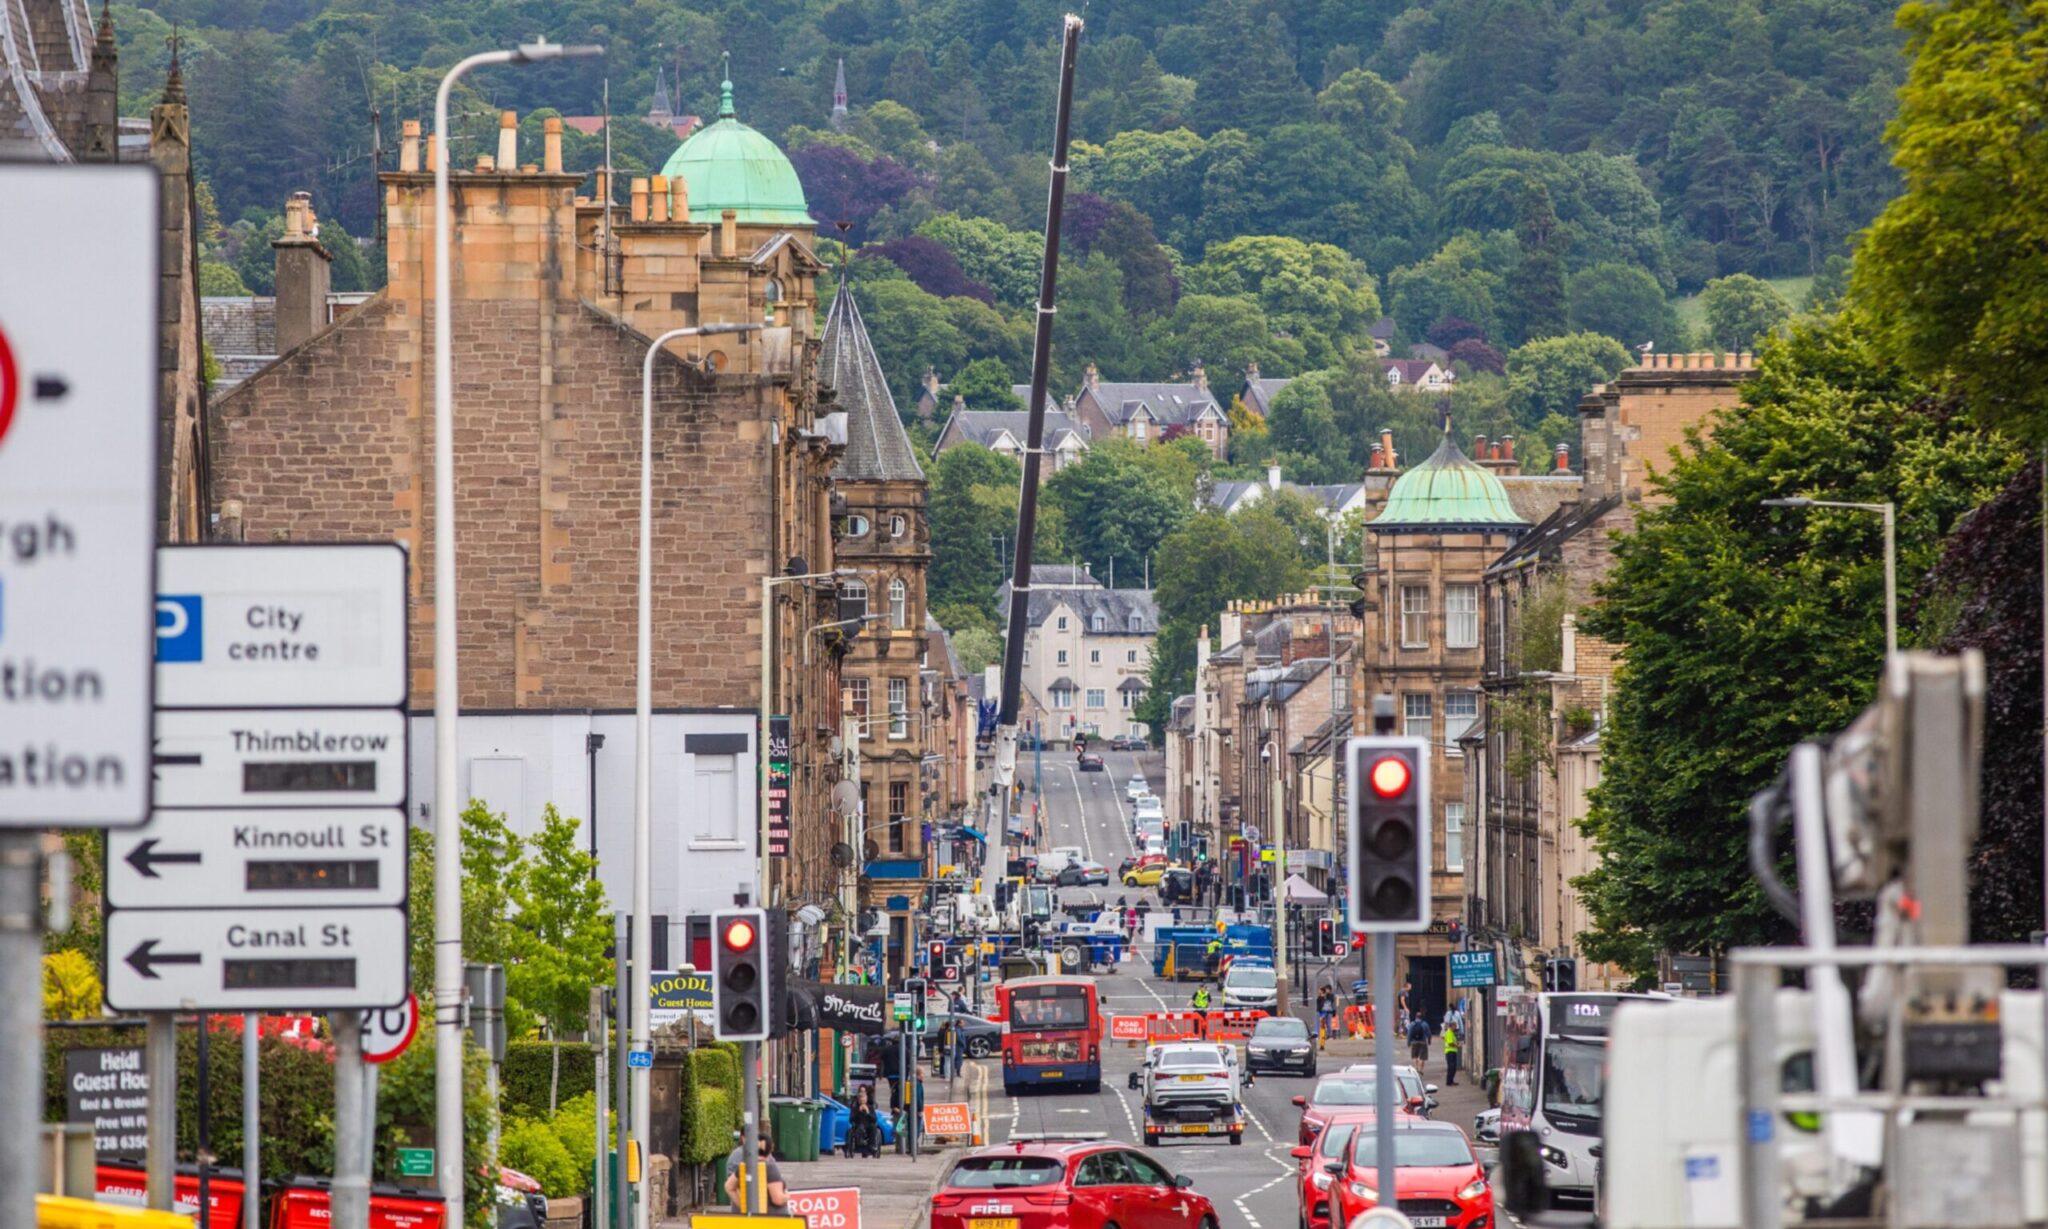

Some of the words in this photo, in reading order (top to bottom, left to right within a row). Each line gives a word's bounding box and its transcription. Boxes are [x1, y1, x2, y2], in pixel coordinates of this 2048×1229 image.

[246, 604, 303, 633] City
[228, 640, 319, 661] centre
[230, 730, 389, 751] Thimblerow
[769, 737, 788, 749] ALL
[234, 827, 344, 847] Kinnoull
[360, 826, 389, 847] St
[227, 925, 306, 947] Canal
[322, 925, 351, 946] St
[1453, 954, 1468, 963] TO
[1472, 953, 1490, 963] LET
[73, 1073, 117, 1091] Guest
[120, 1071, 149, 1090] Hou
[787, 1197, 839, 1213] ROAD
[971, 1204, 1013, 1215] FIRE
